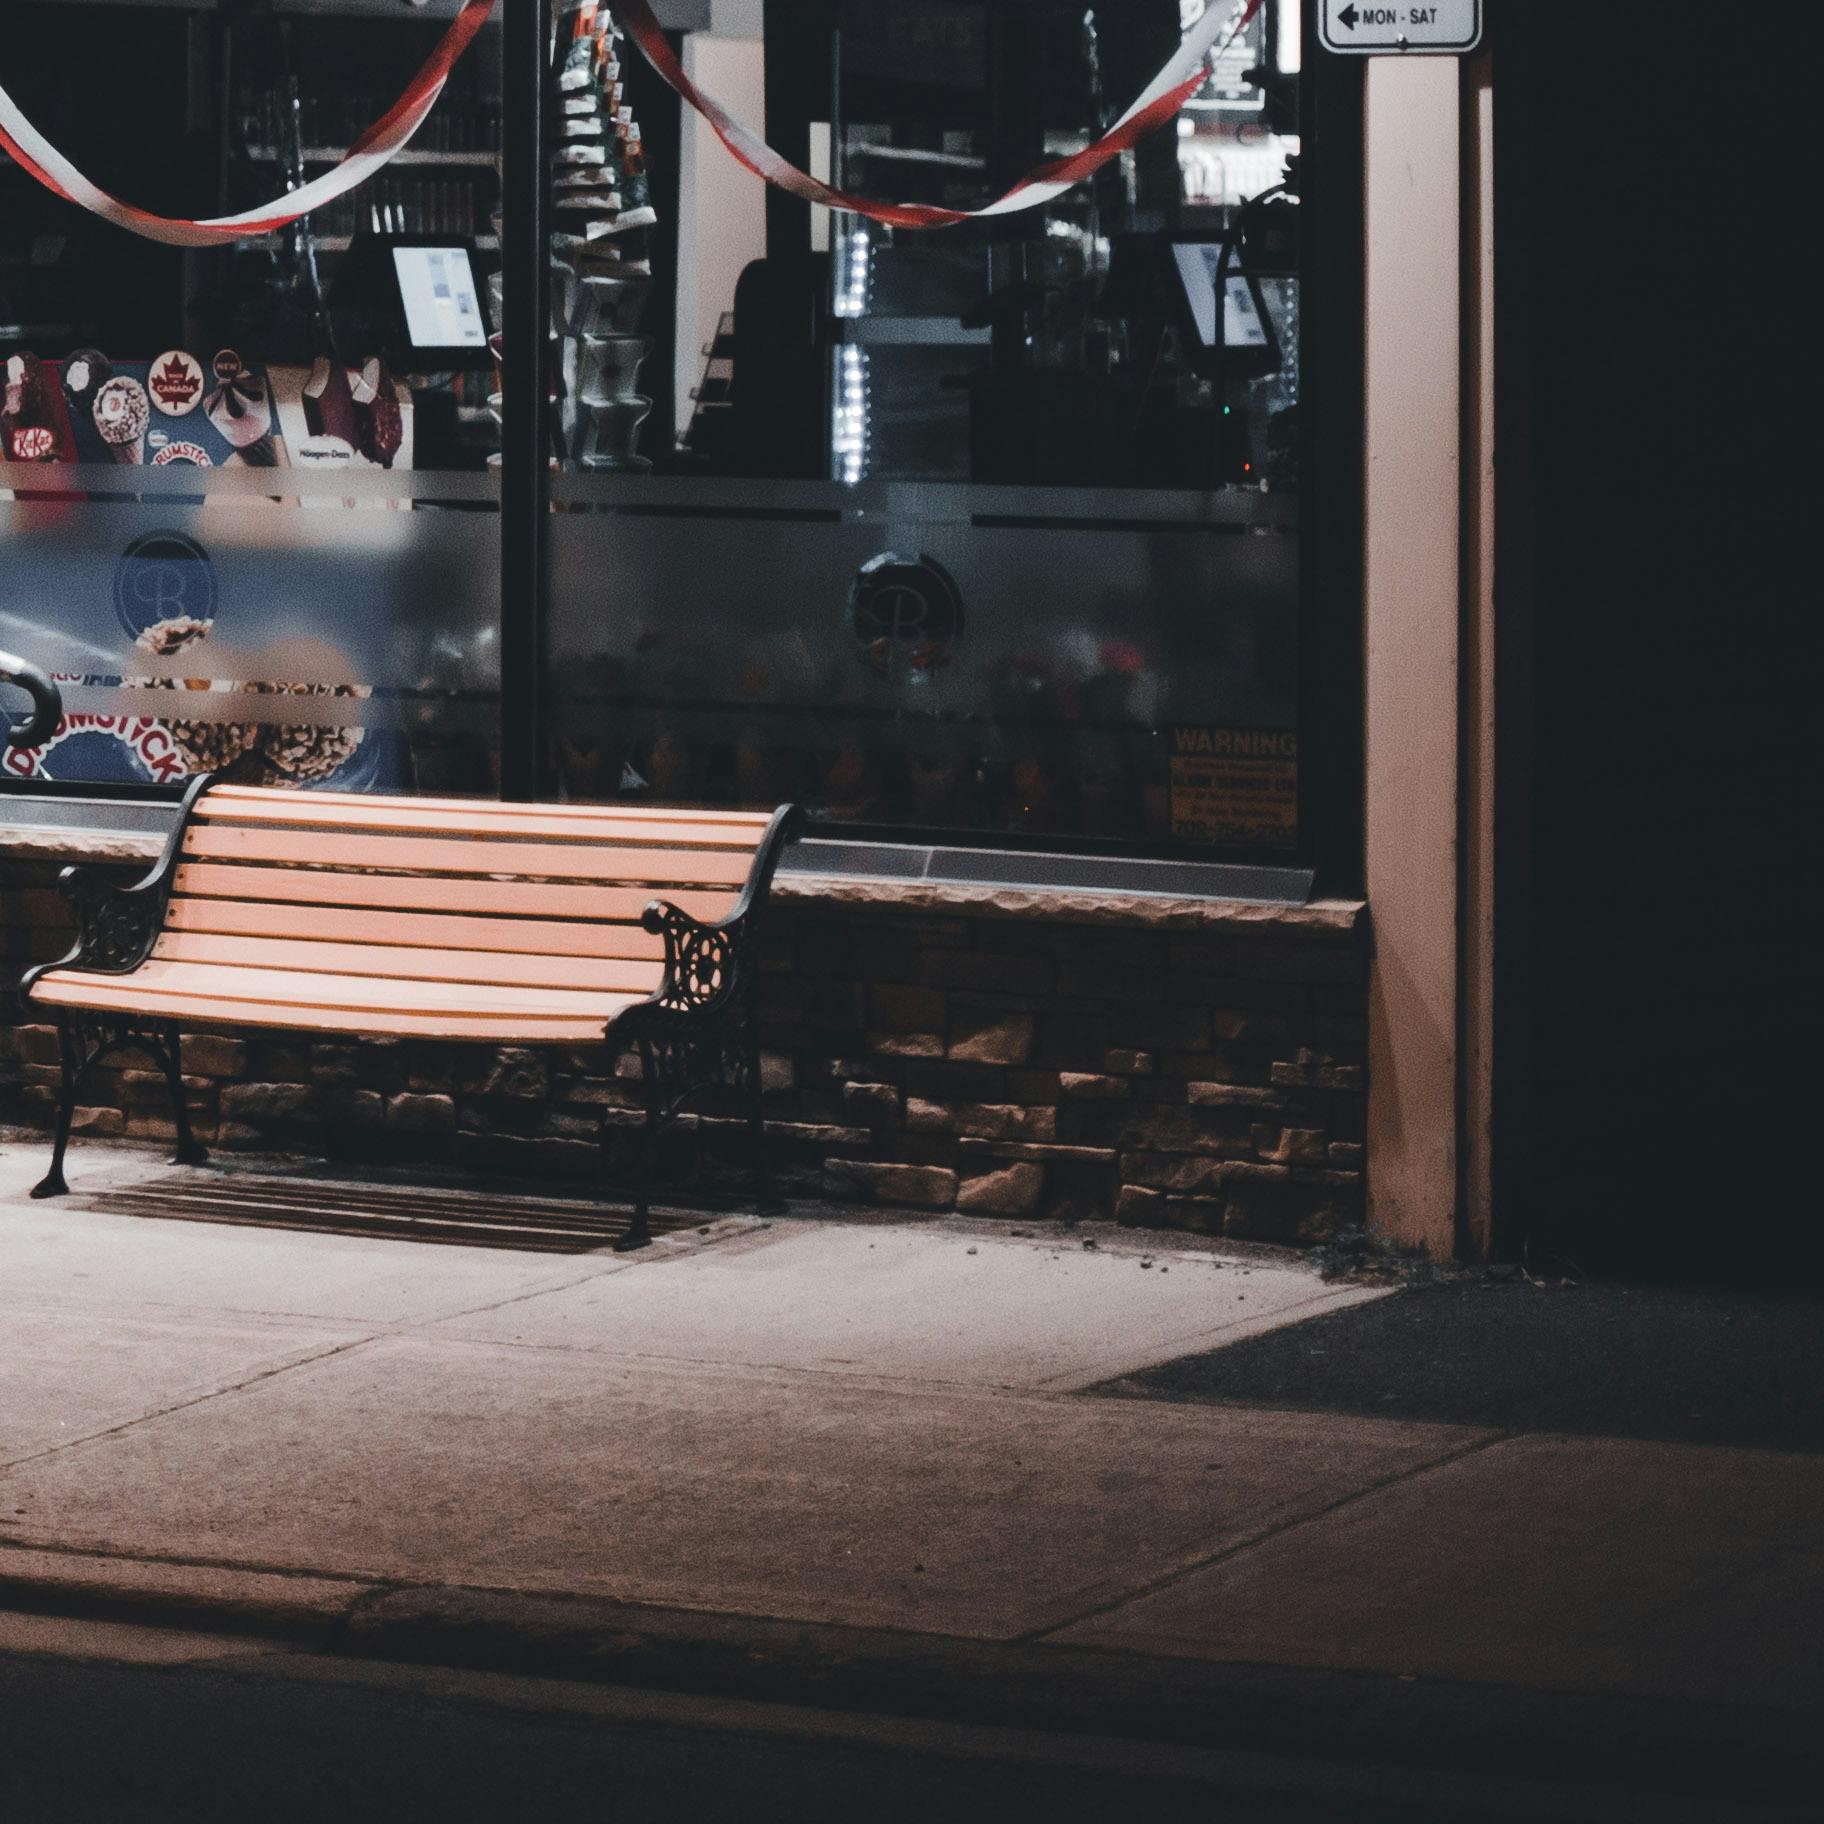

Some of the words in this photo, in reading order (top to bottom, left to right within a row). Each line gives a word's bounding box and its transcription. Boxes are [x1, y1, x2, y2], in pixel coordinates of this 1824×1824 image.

[1363, 10, 1396, 24] MON
[1410, 9, 1437, 24] SAT
[157, 385, 194, 393] CANADA
[1174, 727, 1297, 756] WARNING
